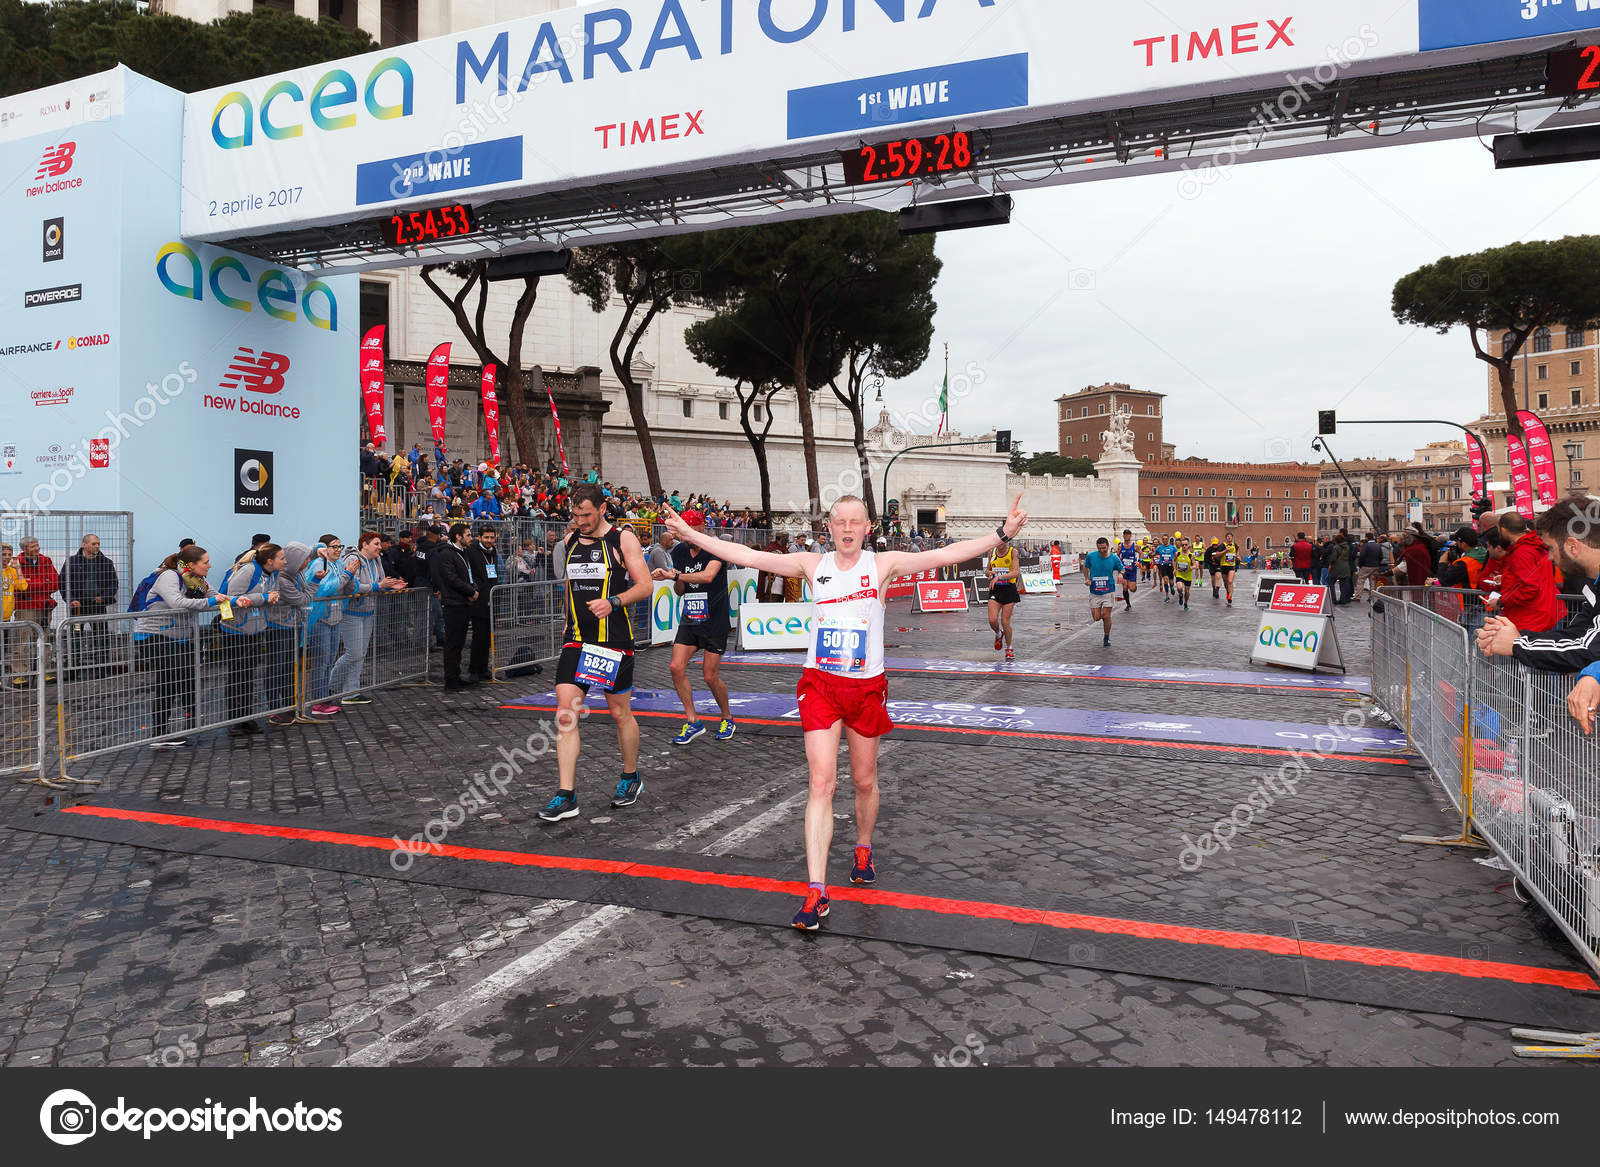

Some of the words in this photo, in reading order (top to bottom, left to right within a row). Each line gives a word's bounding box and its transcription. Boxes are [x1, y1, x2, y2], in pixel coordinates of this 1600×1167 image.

[455, 0, 996, 104] MARATO
[1133, 16, 1295, 66] TIMEX
[211, 57, 414, 150] acea
[857, 90, 882, 115] 1st
[888, 80, 949, 110] WAVE
[594, 110, 705, 149] TIMEX
[403, 164, 424, 186] 2nd
[428, 157, 471, 182] WAVE
[860, 132, 971, 182] 2:59:28
[26, 186, 44, 198] new
[45, 176, 83, 192] balance
[208, 201, 218, 216] 2
[222, 194, 263, 217] aprile
[268, 187, 303, 207] 2017
[391, 204, 470, 245] 2:54:53
[156, 242, 337, 332] acea
[77, 334, 110, 347] CONAD
[204, 394, 236, 411] new
[240, 396, 301, 419] balance
[240, 496, 268, 507] smart
[823, 630, 859, 649] 5070
[1260, 625, 1318, 653] acea
[584, 653, 614, 673] 5828
[886, 702, 1026, 715] cea
[888, 712, 1034, 726] RATONA
